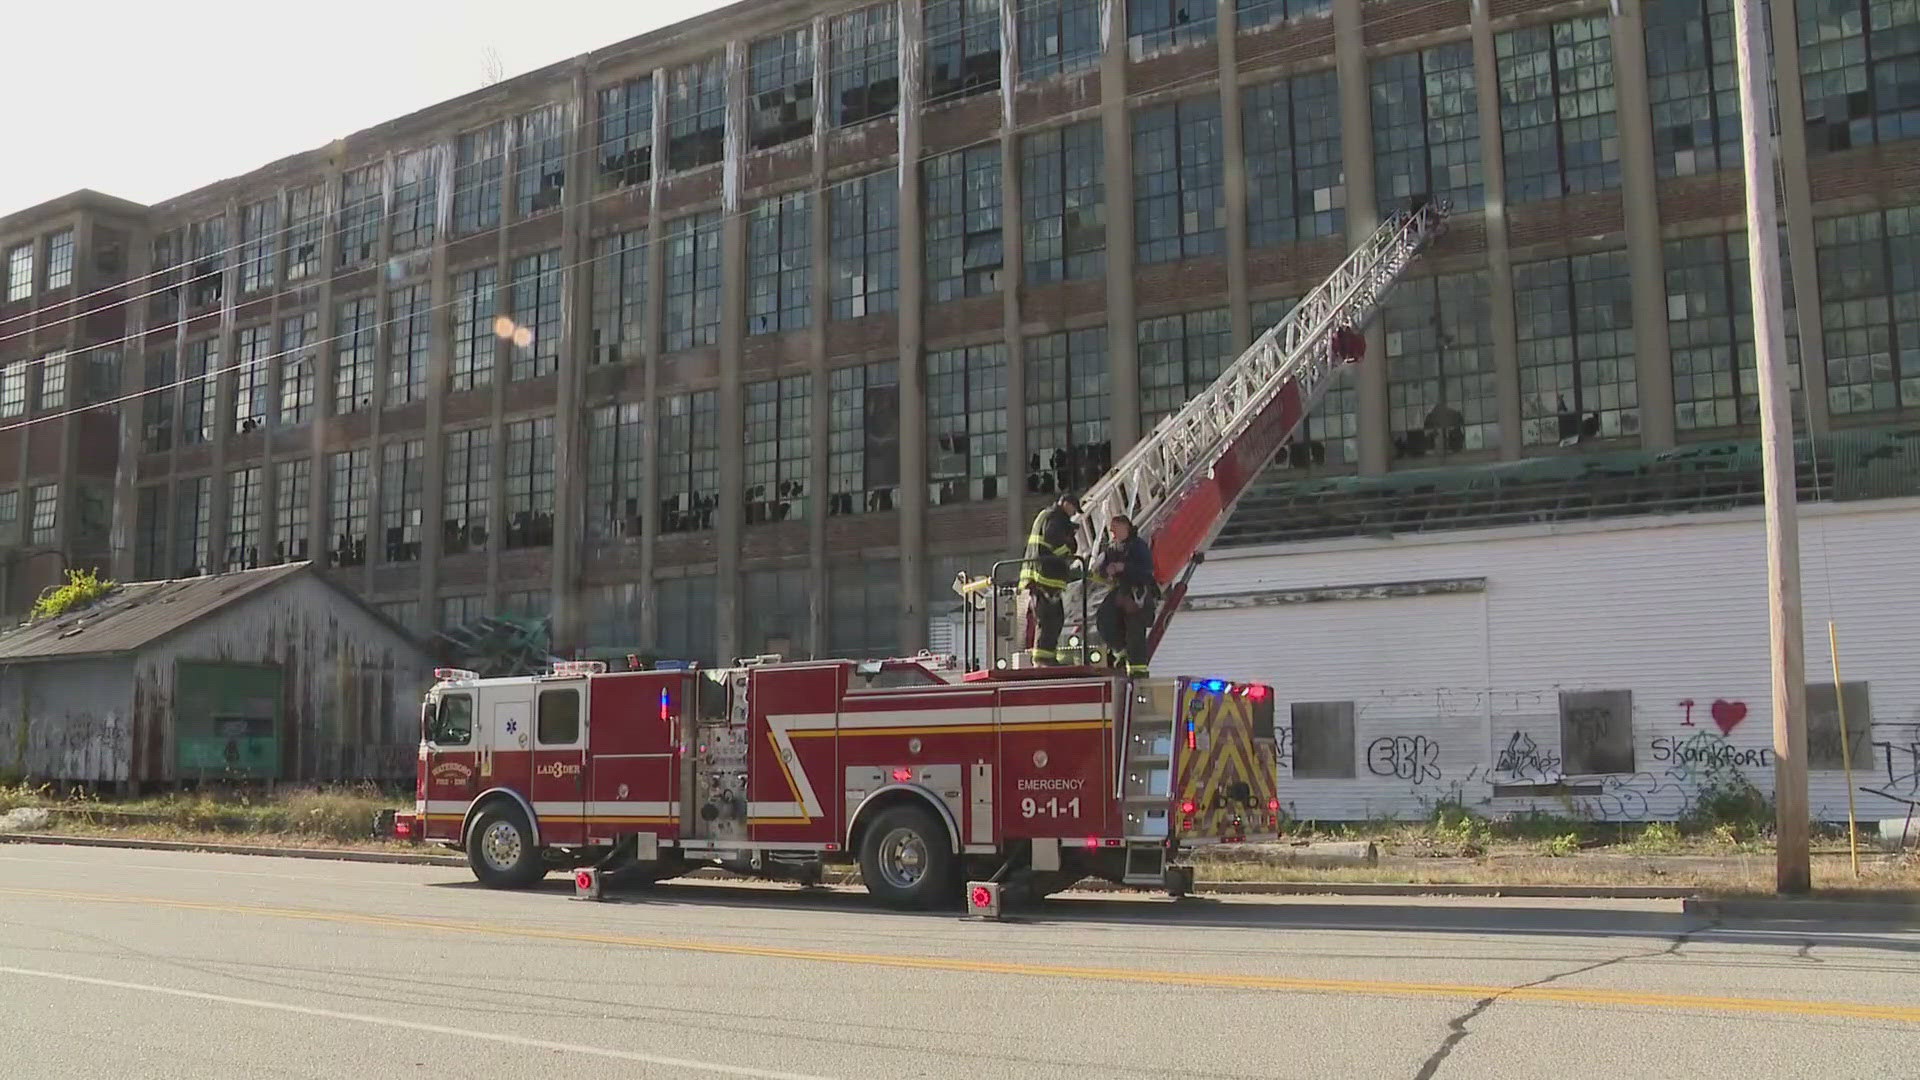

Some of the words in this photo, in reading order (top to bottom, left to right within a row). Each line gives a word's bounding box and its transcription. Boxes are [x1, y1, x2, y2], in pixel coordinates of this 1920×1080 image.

[1679, 699, 1695, 726] I
[1018, 780, 1085, 790] EMERGENCY
[1021, 797, 1080, 818] 9-1-1
